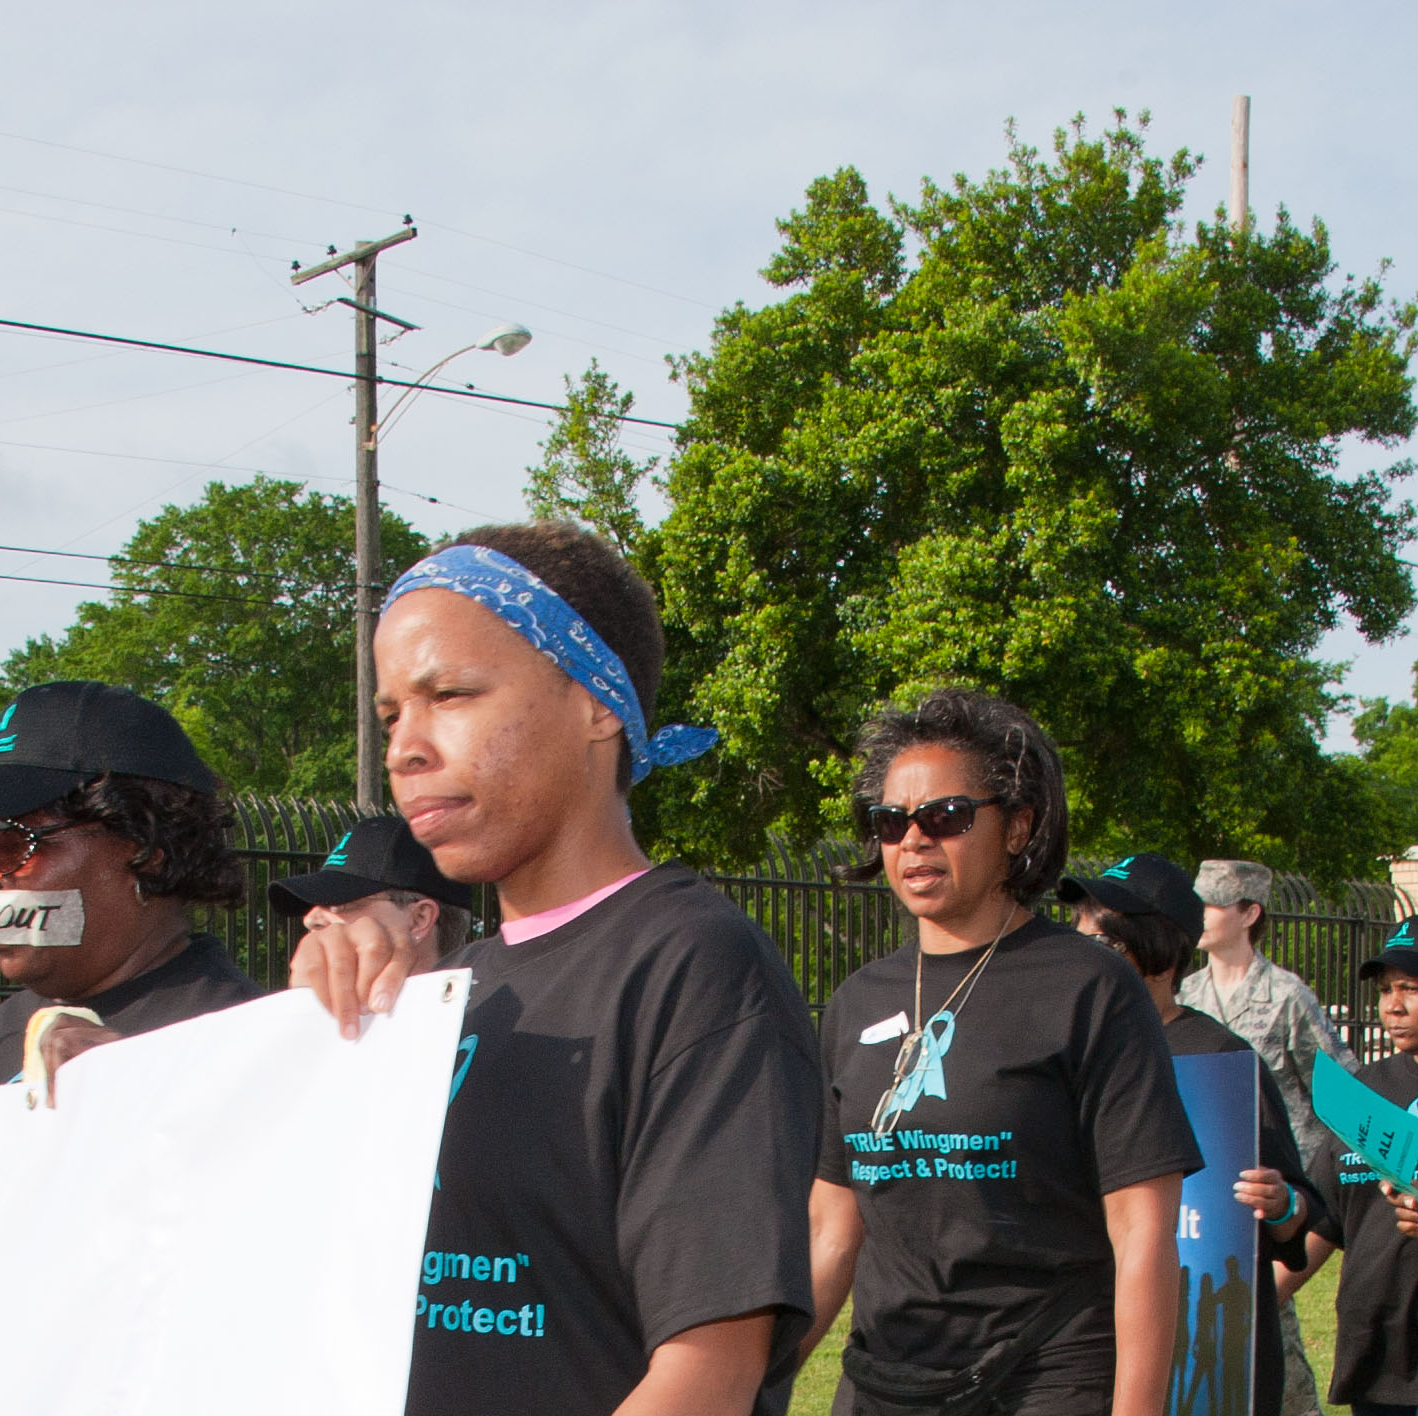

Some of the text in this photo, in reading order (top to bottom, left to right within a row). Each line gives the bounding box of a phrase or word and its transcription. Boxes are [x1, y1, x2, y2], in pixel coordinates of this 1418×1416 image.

[897, 1129, 1013, 1154] Wingmen"
[1377, 1130, 1396, 1160] ALL
[851, 1157, 1017, 1185] Respect & Protect!
